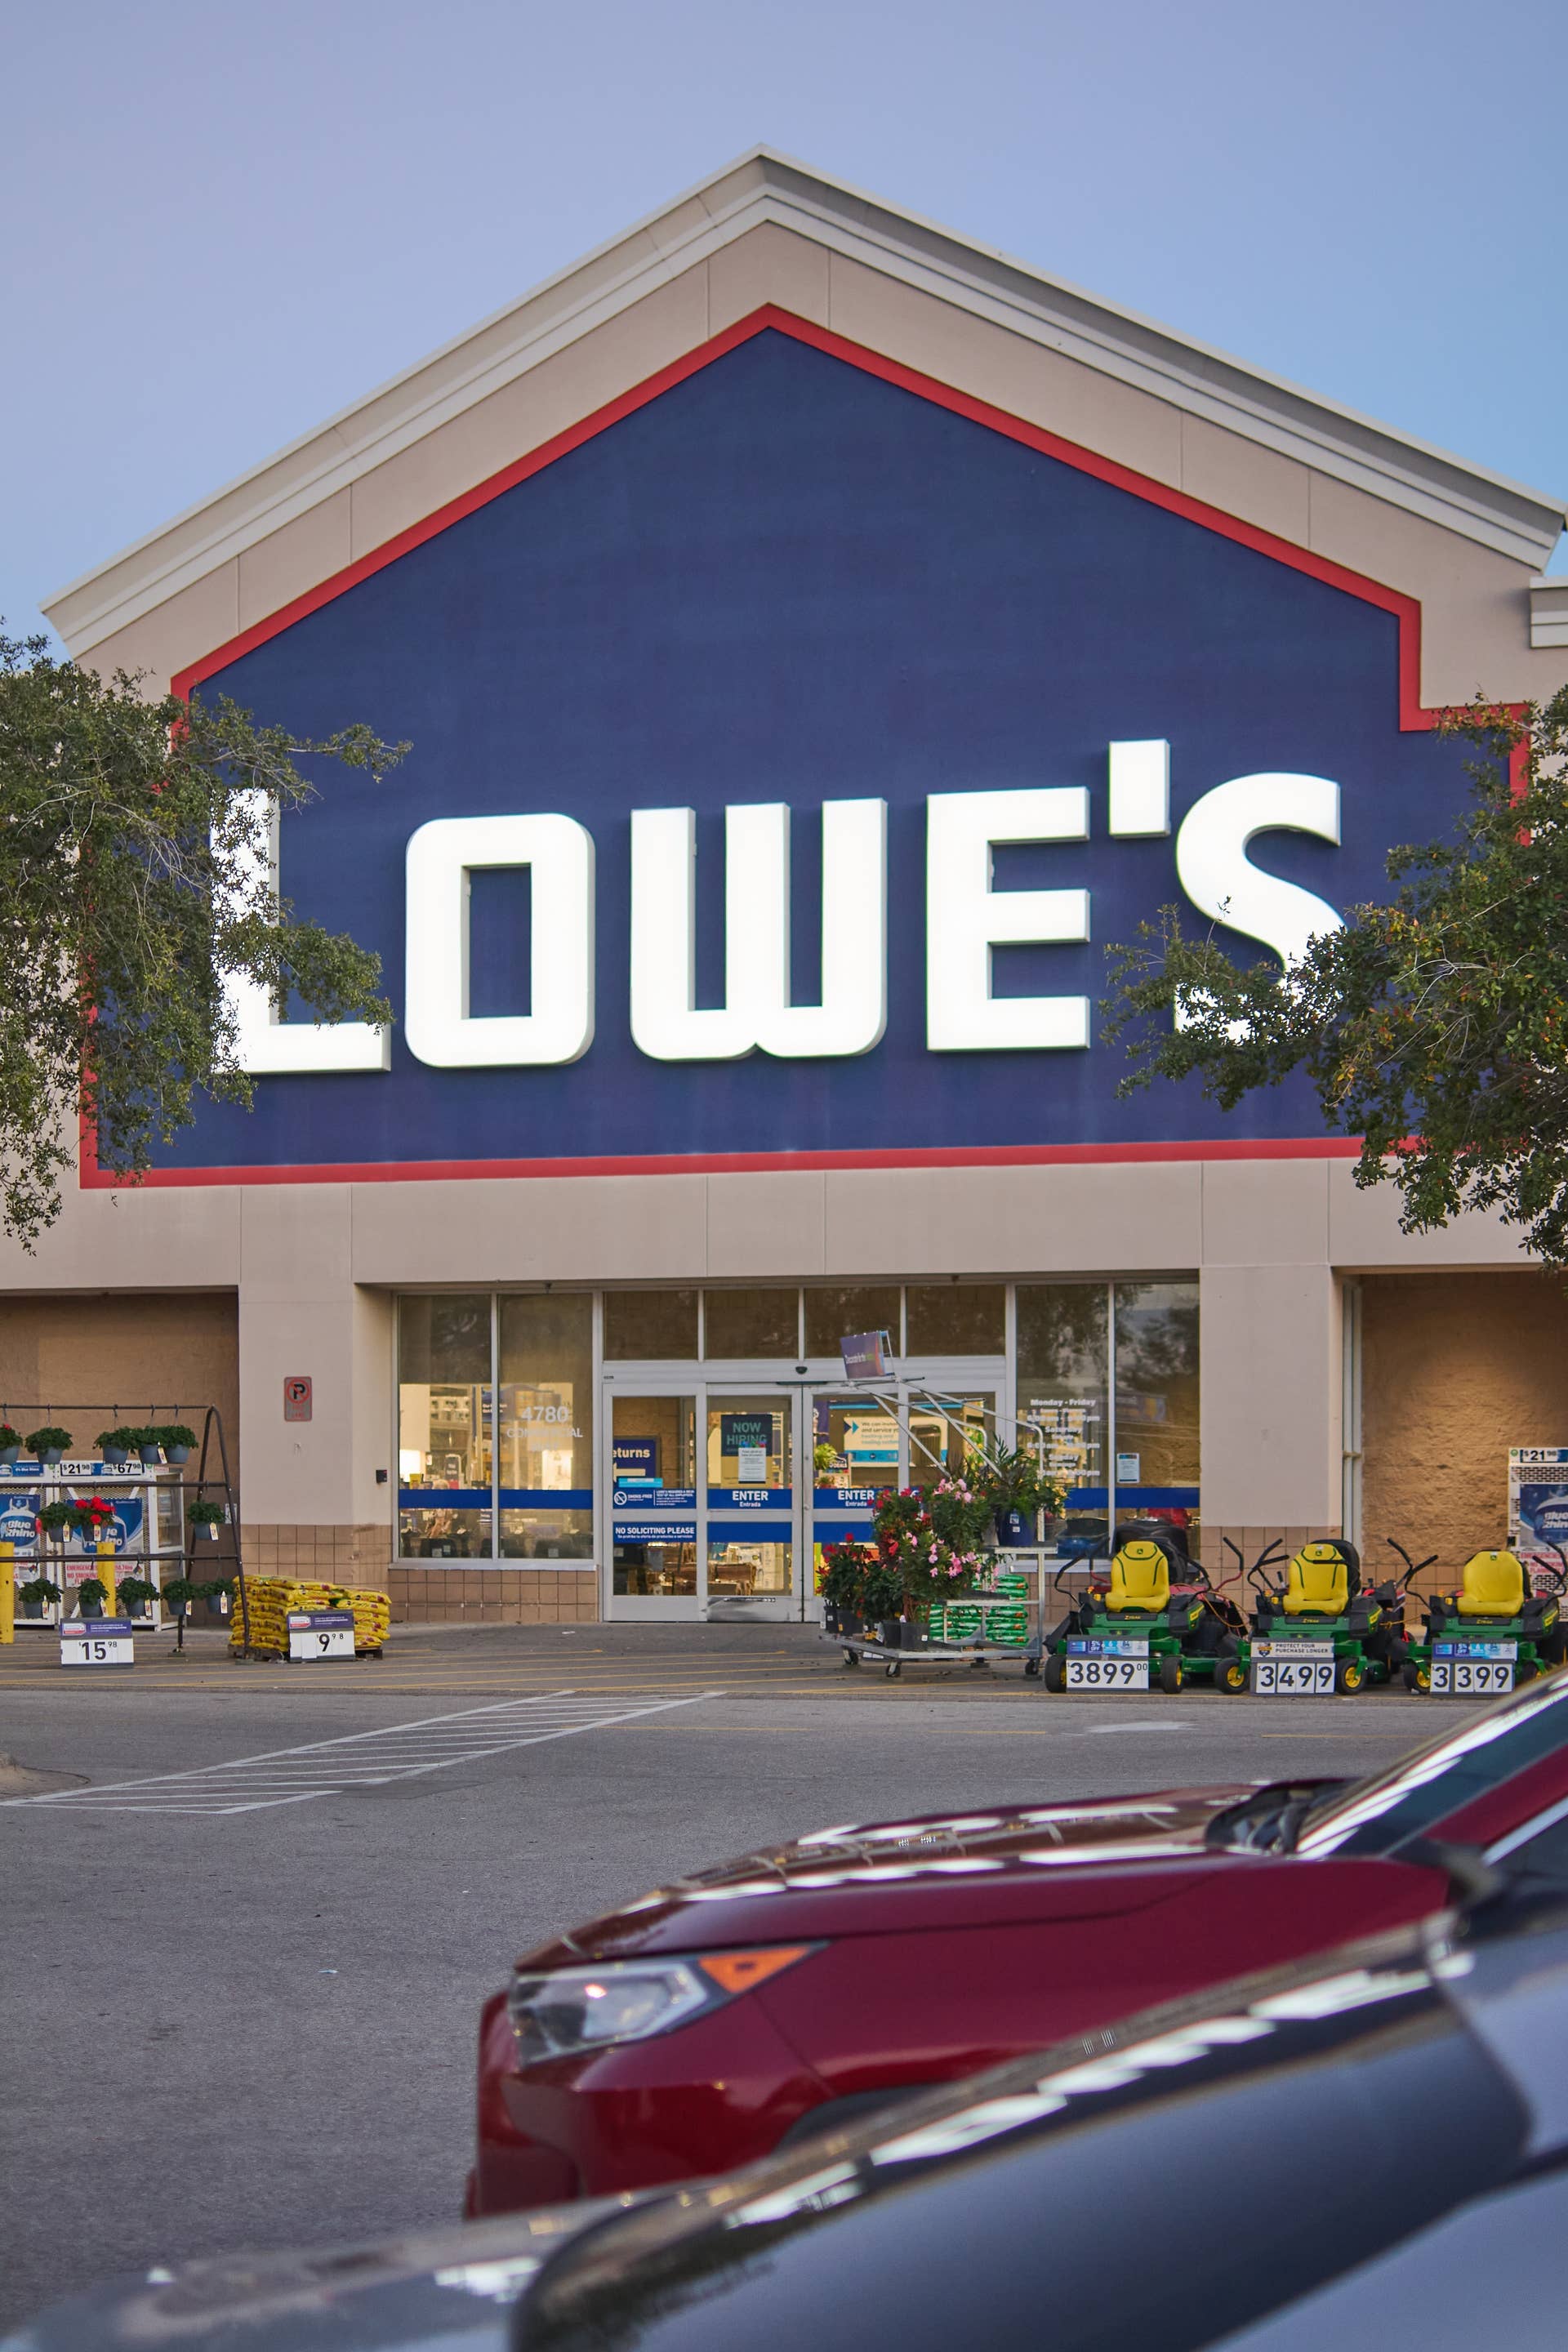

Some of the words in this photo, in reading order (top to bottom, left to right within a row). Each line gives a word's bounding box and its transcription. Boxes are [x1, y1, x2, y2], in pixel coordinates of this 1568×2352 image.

[211, 739, 1350, 1074] LOWE'S
[521, 1406, 569, 1423] 4780
[733, 1422, 761, 1433] NOW
[726, 1434, 767, 1446] HIRING
[612, 1447, 651, 1458] eturns
[732, 1490, 768, 1501] ENTER
[838, 1490, 875, 1500] ENTER
